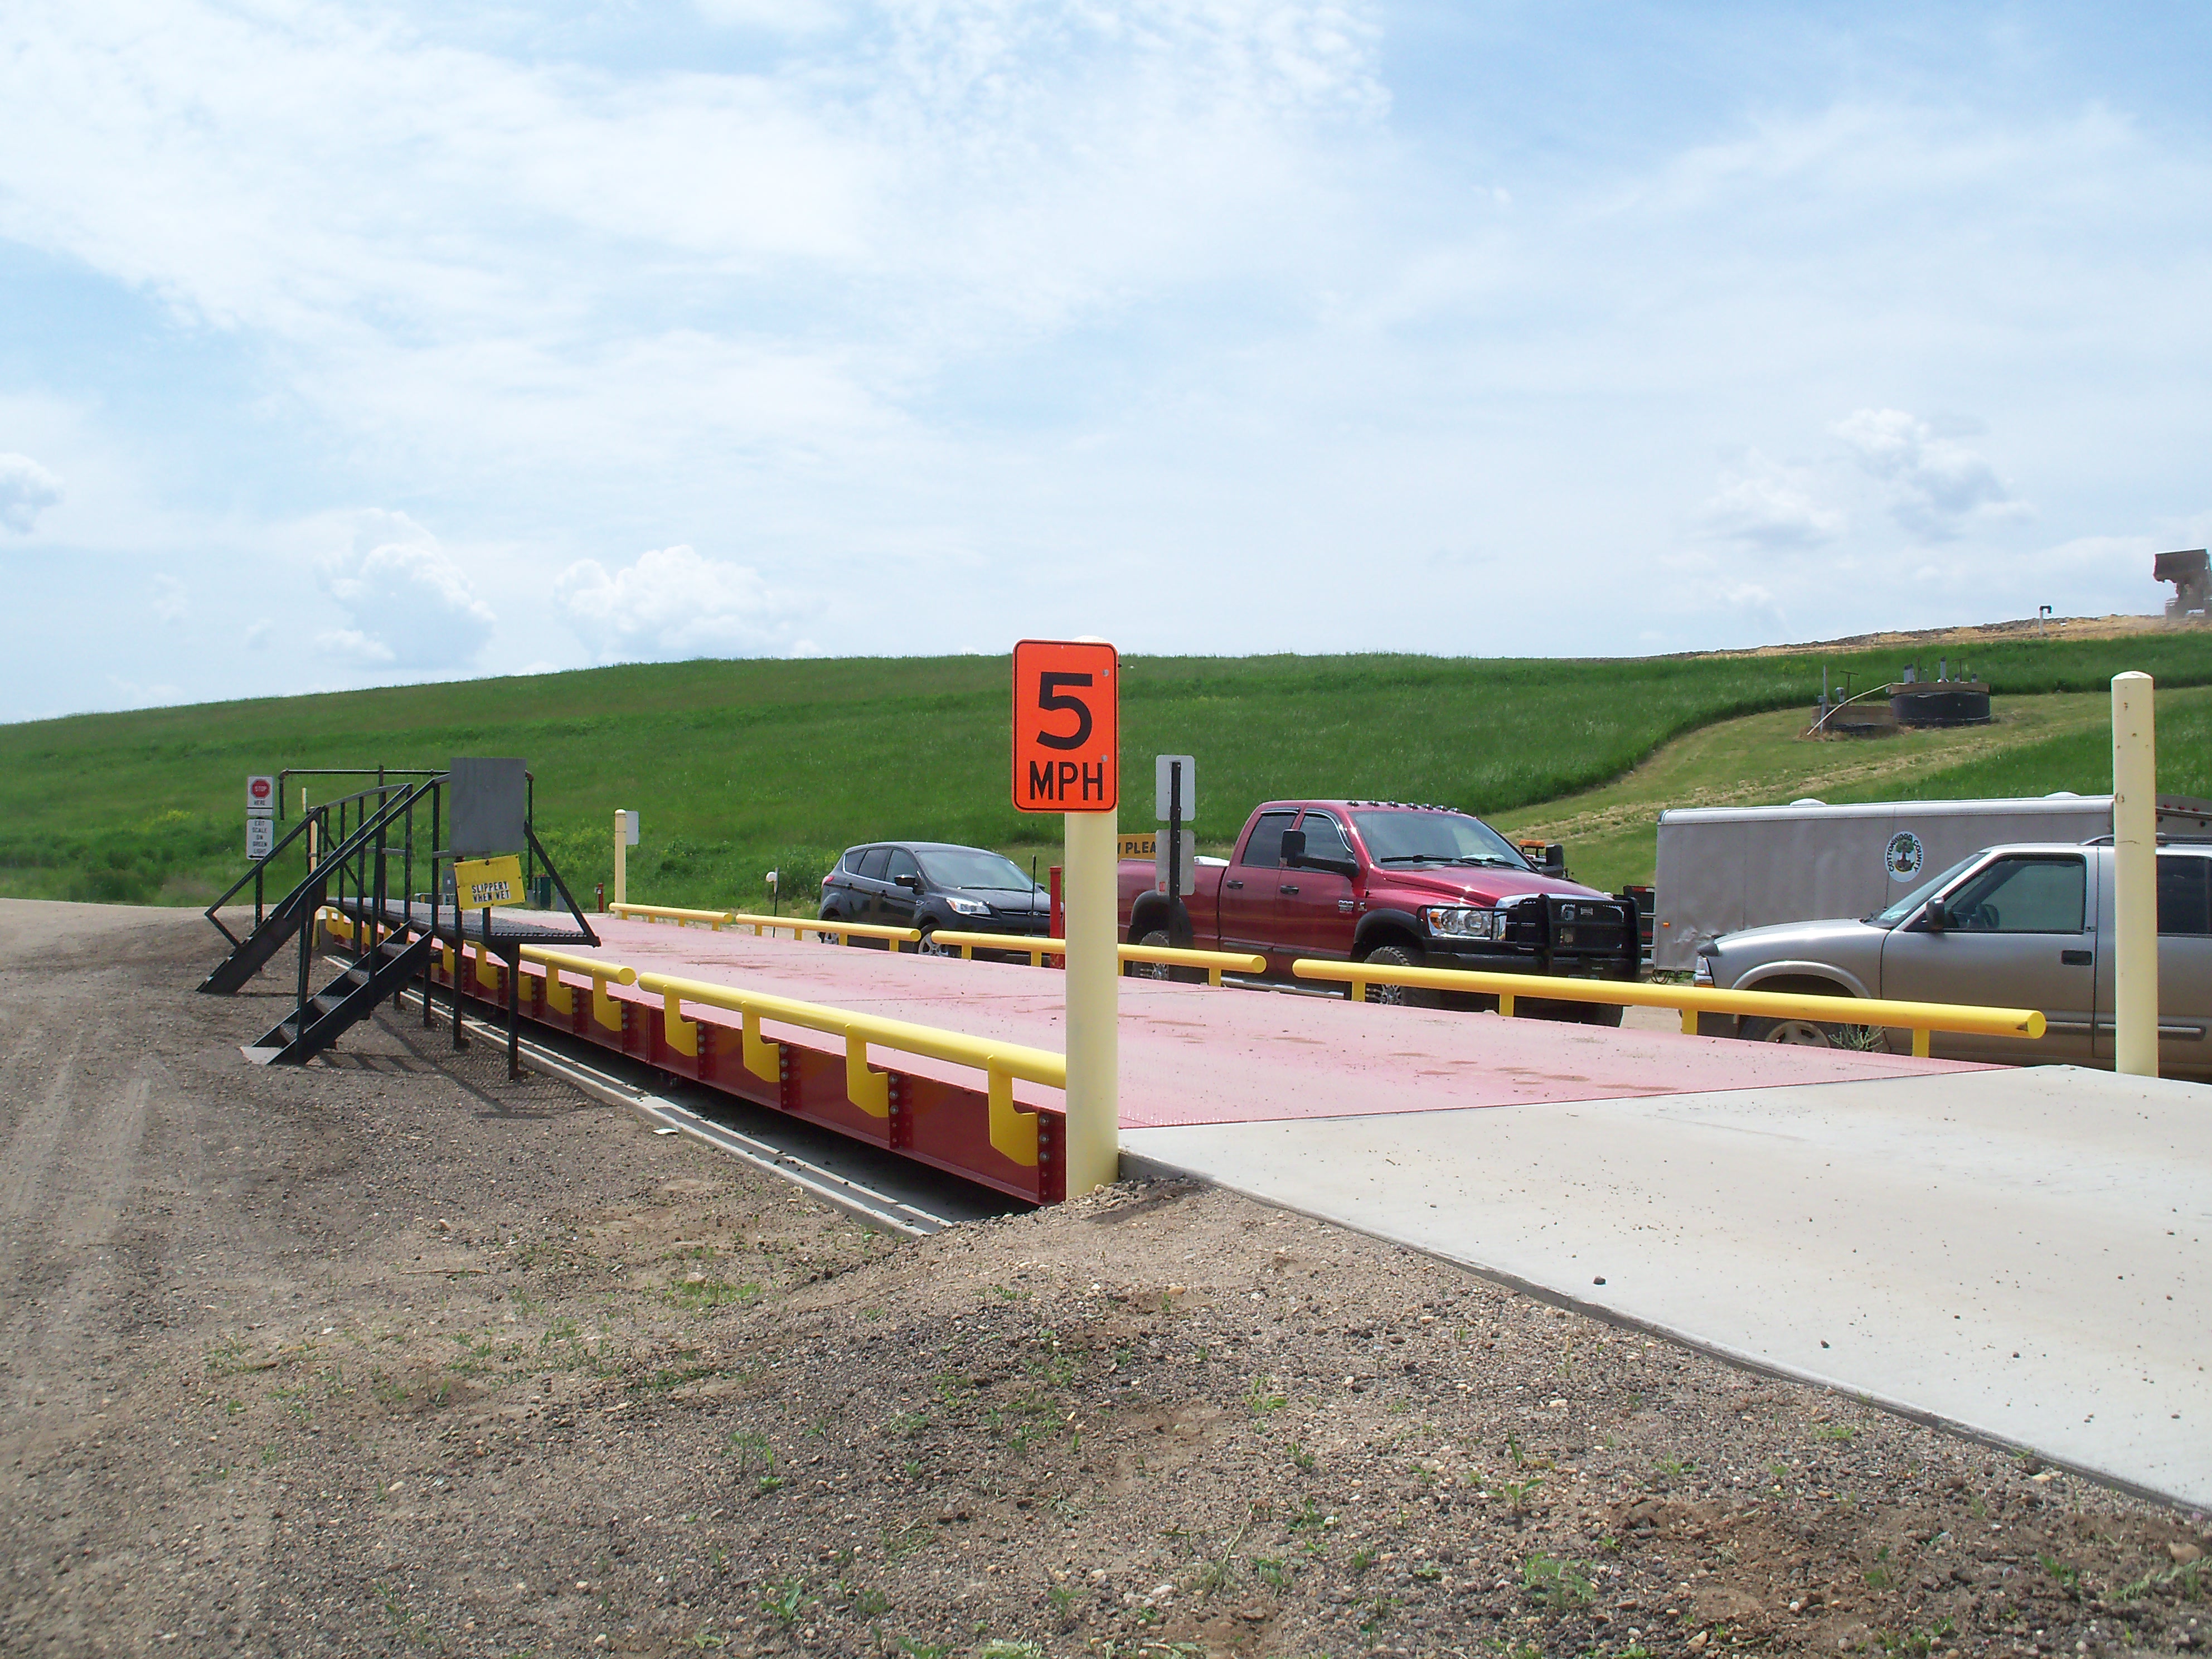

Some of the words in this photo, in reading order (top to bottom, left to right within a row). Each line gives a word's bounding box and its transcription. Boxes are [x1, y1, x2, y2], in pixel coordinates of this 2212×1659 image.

[1036, 672, 1093, 750] 5
[1030, 760, 1103, 801] MPH
[1126, 841, 1156, 854] PLEA
[1886, 833, 1913, 872] COTTONWOOD
[1913, 840, 1922, 872] COUNTY
[472, 881, 508, 894] SLIPPERY
[473, 892, 493, 903] WHEN
[496, 890, 509, 900] WET
